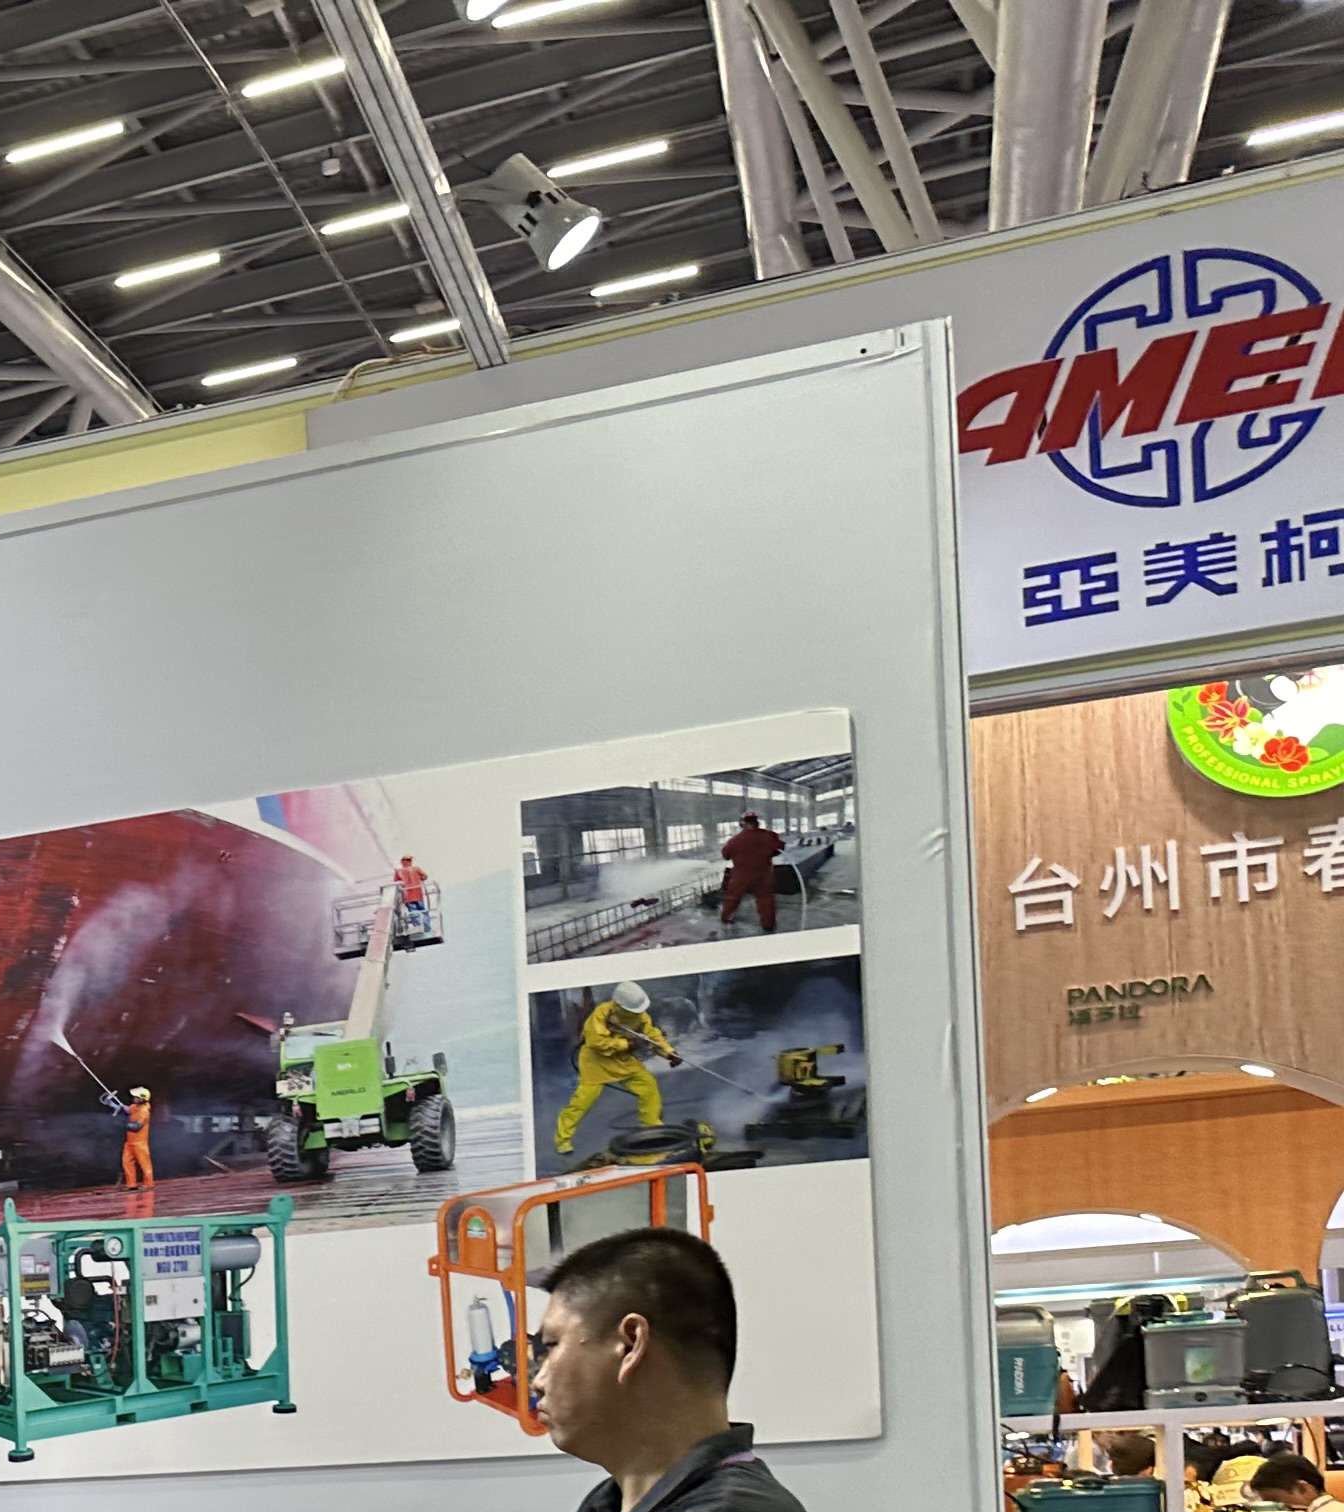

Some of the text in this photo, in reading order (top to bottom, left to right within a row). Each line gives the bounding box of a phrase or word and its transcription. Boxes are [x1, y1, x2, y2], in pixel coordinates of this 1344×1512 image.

[957, 302, 1344, 466] AME
[1022, 508, 1344, 628] 亞美柯
[1182, 725, 1344, 789] PROFESSIONAL SPRAY
[1067, 974, 1215, 1006] PANDORA
